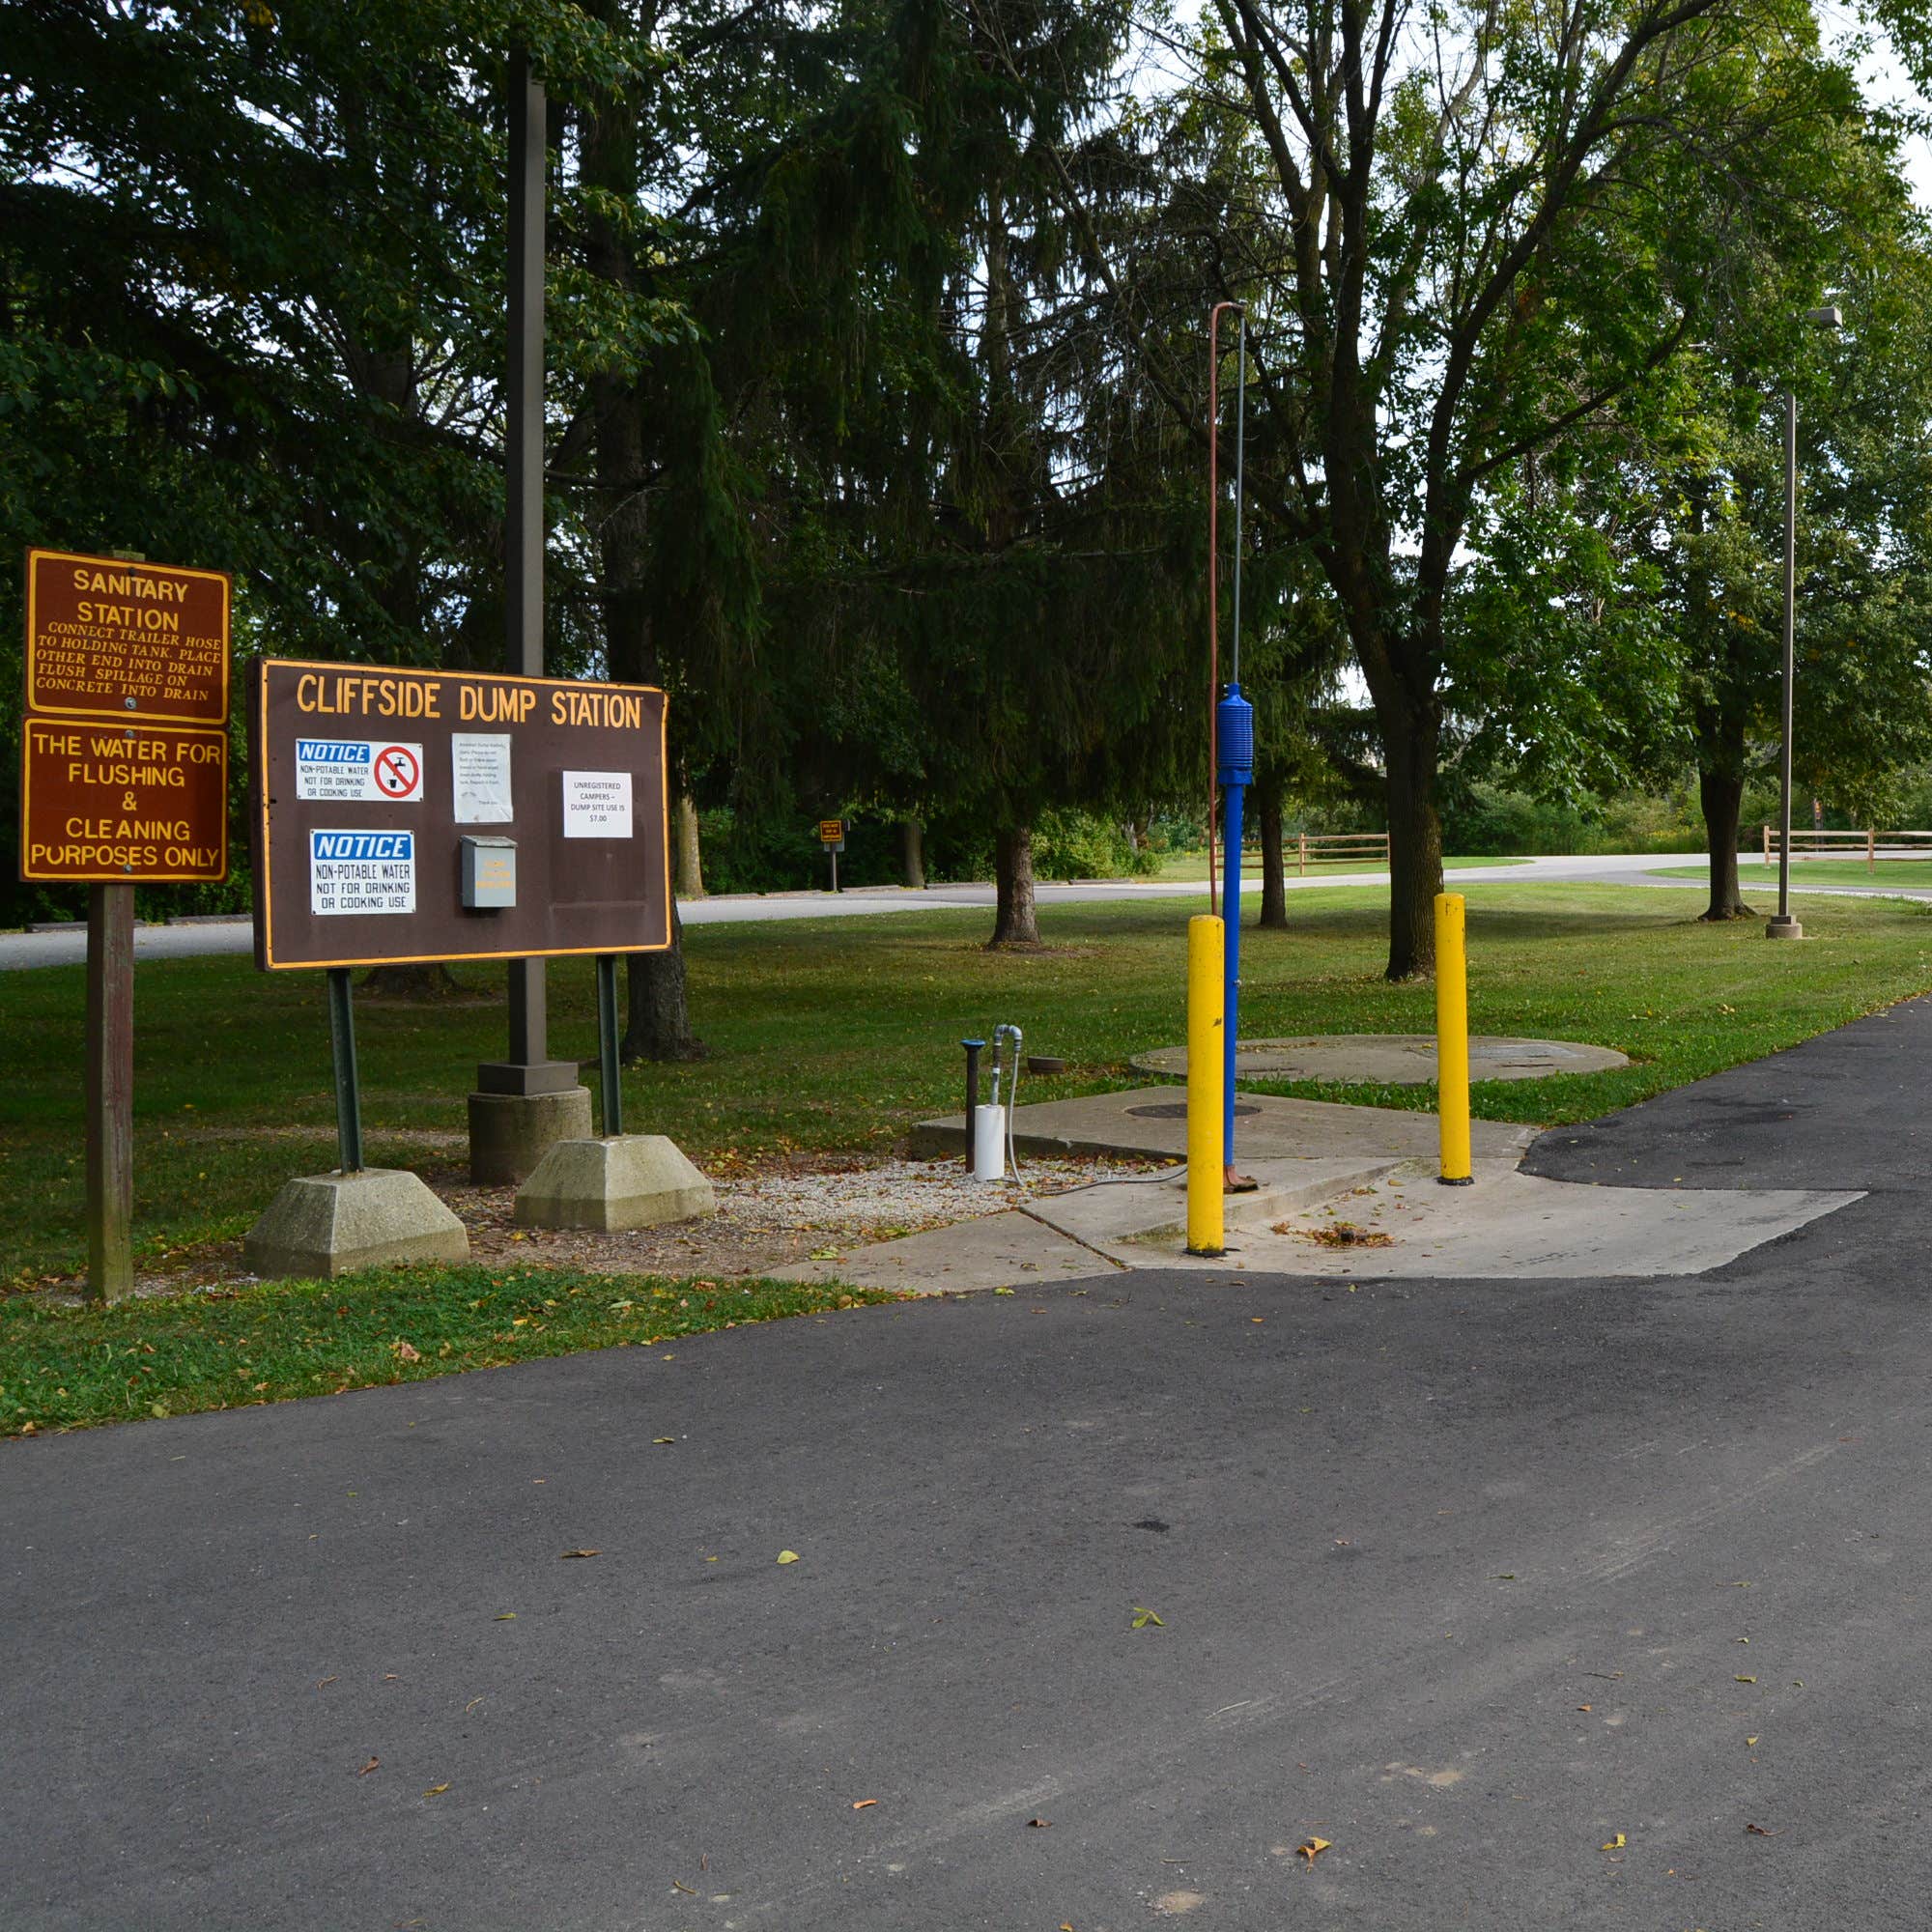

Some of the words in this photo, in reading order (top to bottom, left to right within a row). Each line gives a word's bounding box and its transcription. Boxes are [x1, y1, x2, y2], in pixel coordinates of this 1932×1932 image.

[73, 569, 188, 603] SANITARY
[77, 601, 179, 632] STATION
[47, 621, 115, 639] CONNECT
[119, 629, 180, 645] TRAILER
[185, 636, 221, 650] HOSE
[38, 635, 57, 646] TO
[61, 637, 128, 655] HOLDING
[179, 648, 221, 664] PLACE
[36, 648, 85, 665] OTHER
[91, 654, 123, 668] END
[128, 658, 162, 671] INTO
[168, 662, 213, 676] DRAIN
[38, 663, 86, 677] FLUSH
[95, 668, 163, 685] SPILLAGE
[167, 674, 188, 687] ON
[36, 676, 113, 694] CONCRETE
[121, 683, 156, 697] INTO
[162, 687, 209, 701] DRAIN
[297, 673, 441, 719] CLIFFSIDE
[460, 685, 536, 723] DUMP
[551, 690, 641, 728] STATION
[33, 733, 82, 756] THE
[90, 737, 167, 761] WATER
[176, 742, 221, 765] FOR
[300, 743, 369, 761] NOTICE
[69, 763, 185, 787] FLUSHING
[299, 764, 344, 775] NON-POTABLE
[348, 766, 369, 776] WATER
[304, 776, 317, 785] NOT
[320, 777, 332, 785] FOR
[335, 777, 365, 786] DRINKING
[122, 791, 137, 810] &
[307, 787, 317, 797] OR
[320, 788, 348, 797] COOKING
[350, 788, 363, 798] USE
[580, 792, 611, 801] CAMPERS
[66, 817, 190, 841] CLEANING
[31, 843, 157, 867] PURPOSES
[165, 846, 219, 867] ONLY
[317, 836, 409, 858] NOTICE
[316, 864, 377, 880] NON-POTABLE
[382, 864, 411, 879] WATER
[317, 883, 335, 895] NOT
[341, 882, 360, 895] FOR
[365, 882, 410, 894] DRINKING
[321, 896, 335, 909] OR
[340, 896, 384, 908] COOKING
[388, 896, 407, 907] USE
